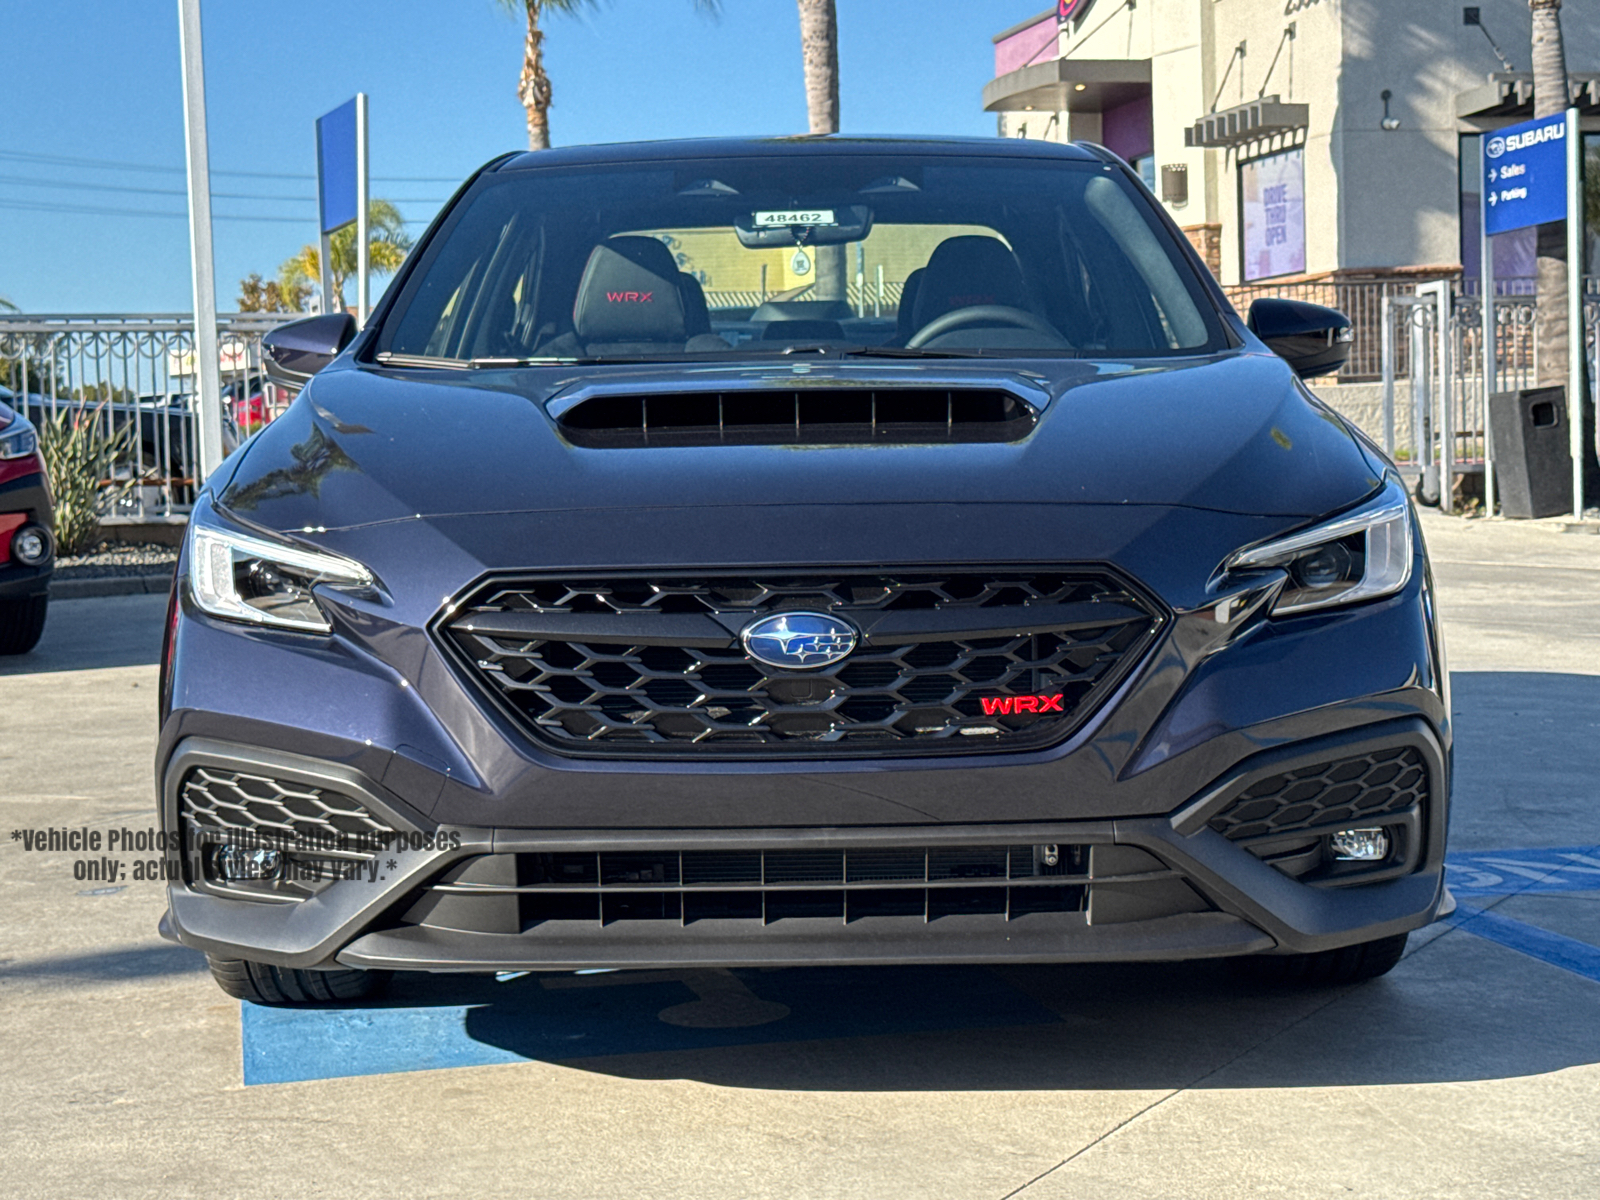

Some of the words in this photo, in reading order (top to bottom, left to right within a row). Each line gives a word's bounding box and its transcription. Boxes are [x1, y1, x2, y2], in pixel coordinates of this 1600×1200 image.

[1506, 122, 1565, 152] SUBARU
[1500, 164, 1526, 179] Sales
[764, 213, 822, 223] 48462
[606, 291, 653, 303] WRX
[981, 693, 1064, 715] WRX
